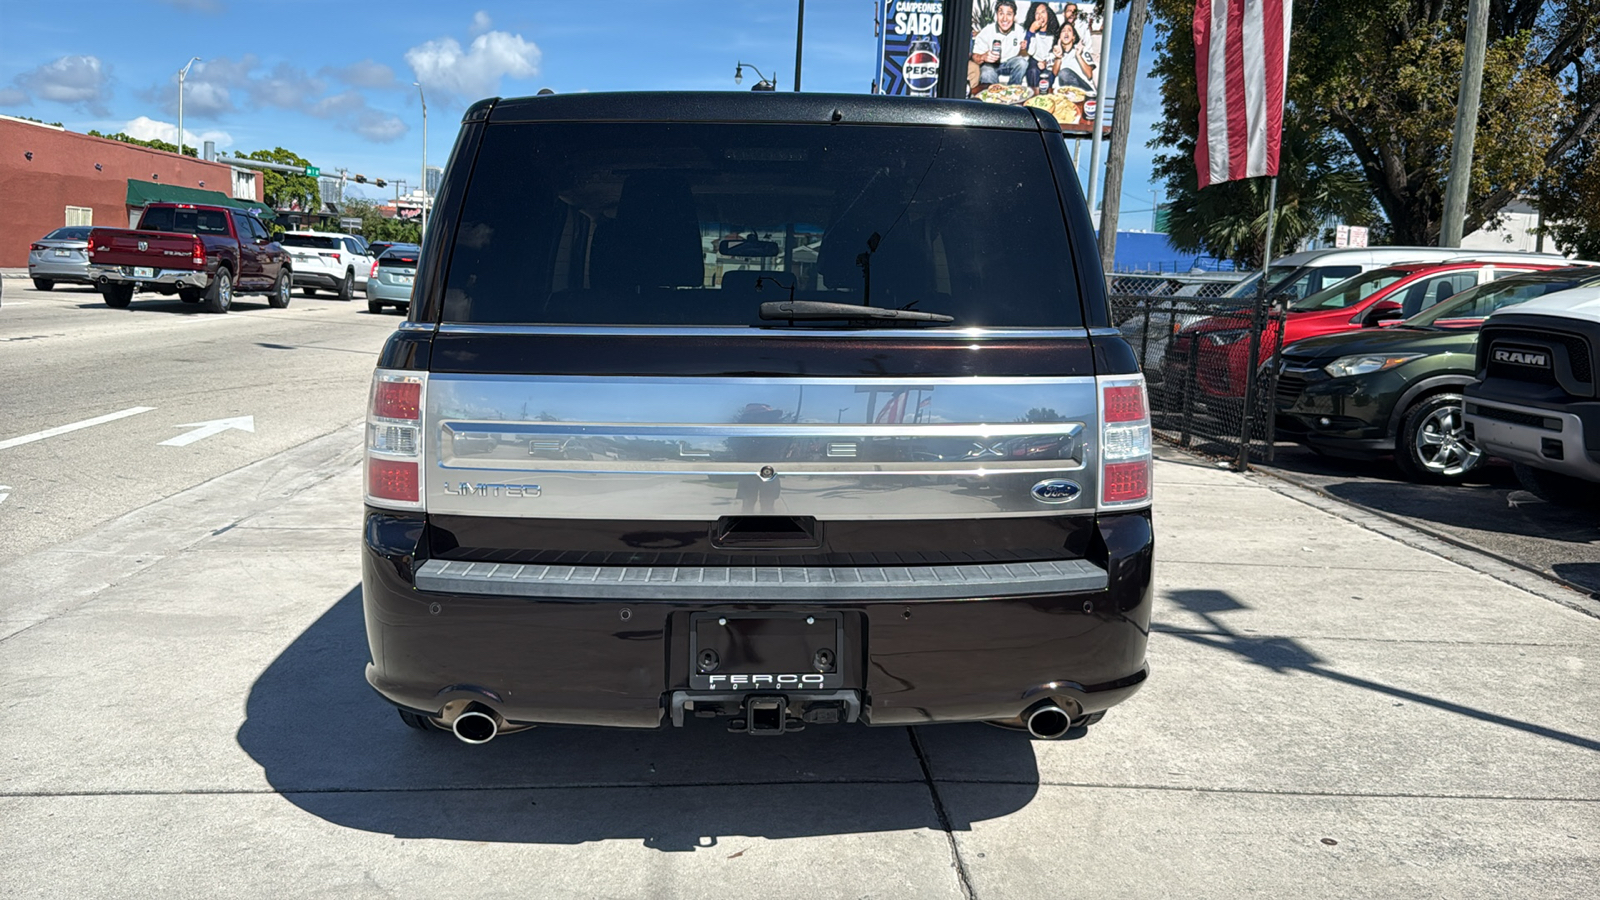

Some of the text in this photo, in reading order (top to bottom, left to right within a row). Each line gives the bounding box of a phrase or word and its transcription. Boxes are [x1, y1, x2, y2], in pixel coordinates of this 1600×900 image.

[896, 2, 942, 13] CAMPEONES
[895, 12, 943, 36] SABO
[1084, 52, 1093, 62] 9
[1495, 351, 1545, 365] RAM
[444, 482, 541, 498] LIMITED
[709, 674, 824, 684] FERCO
